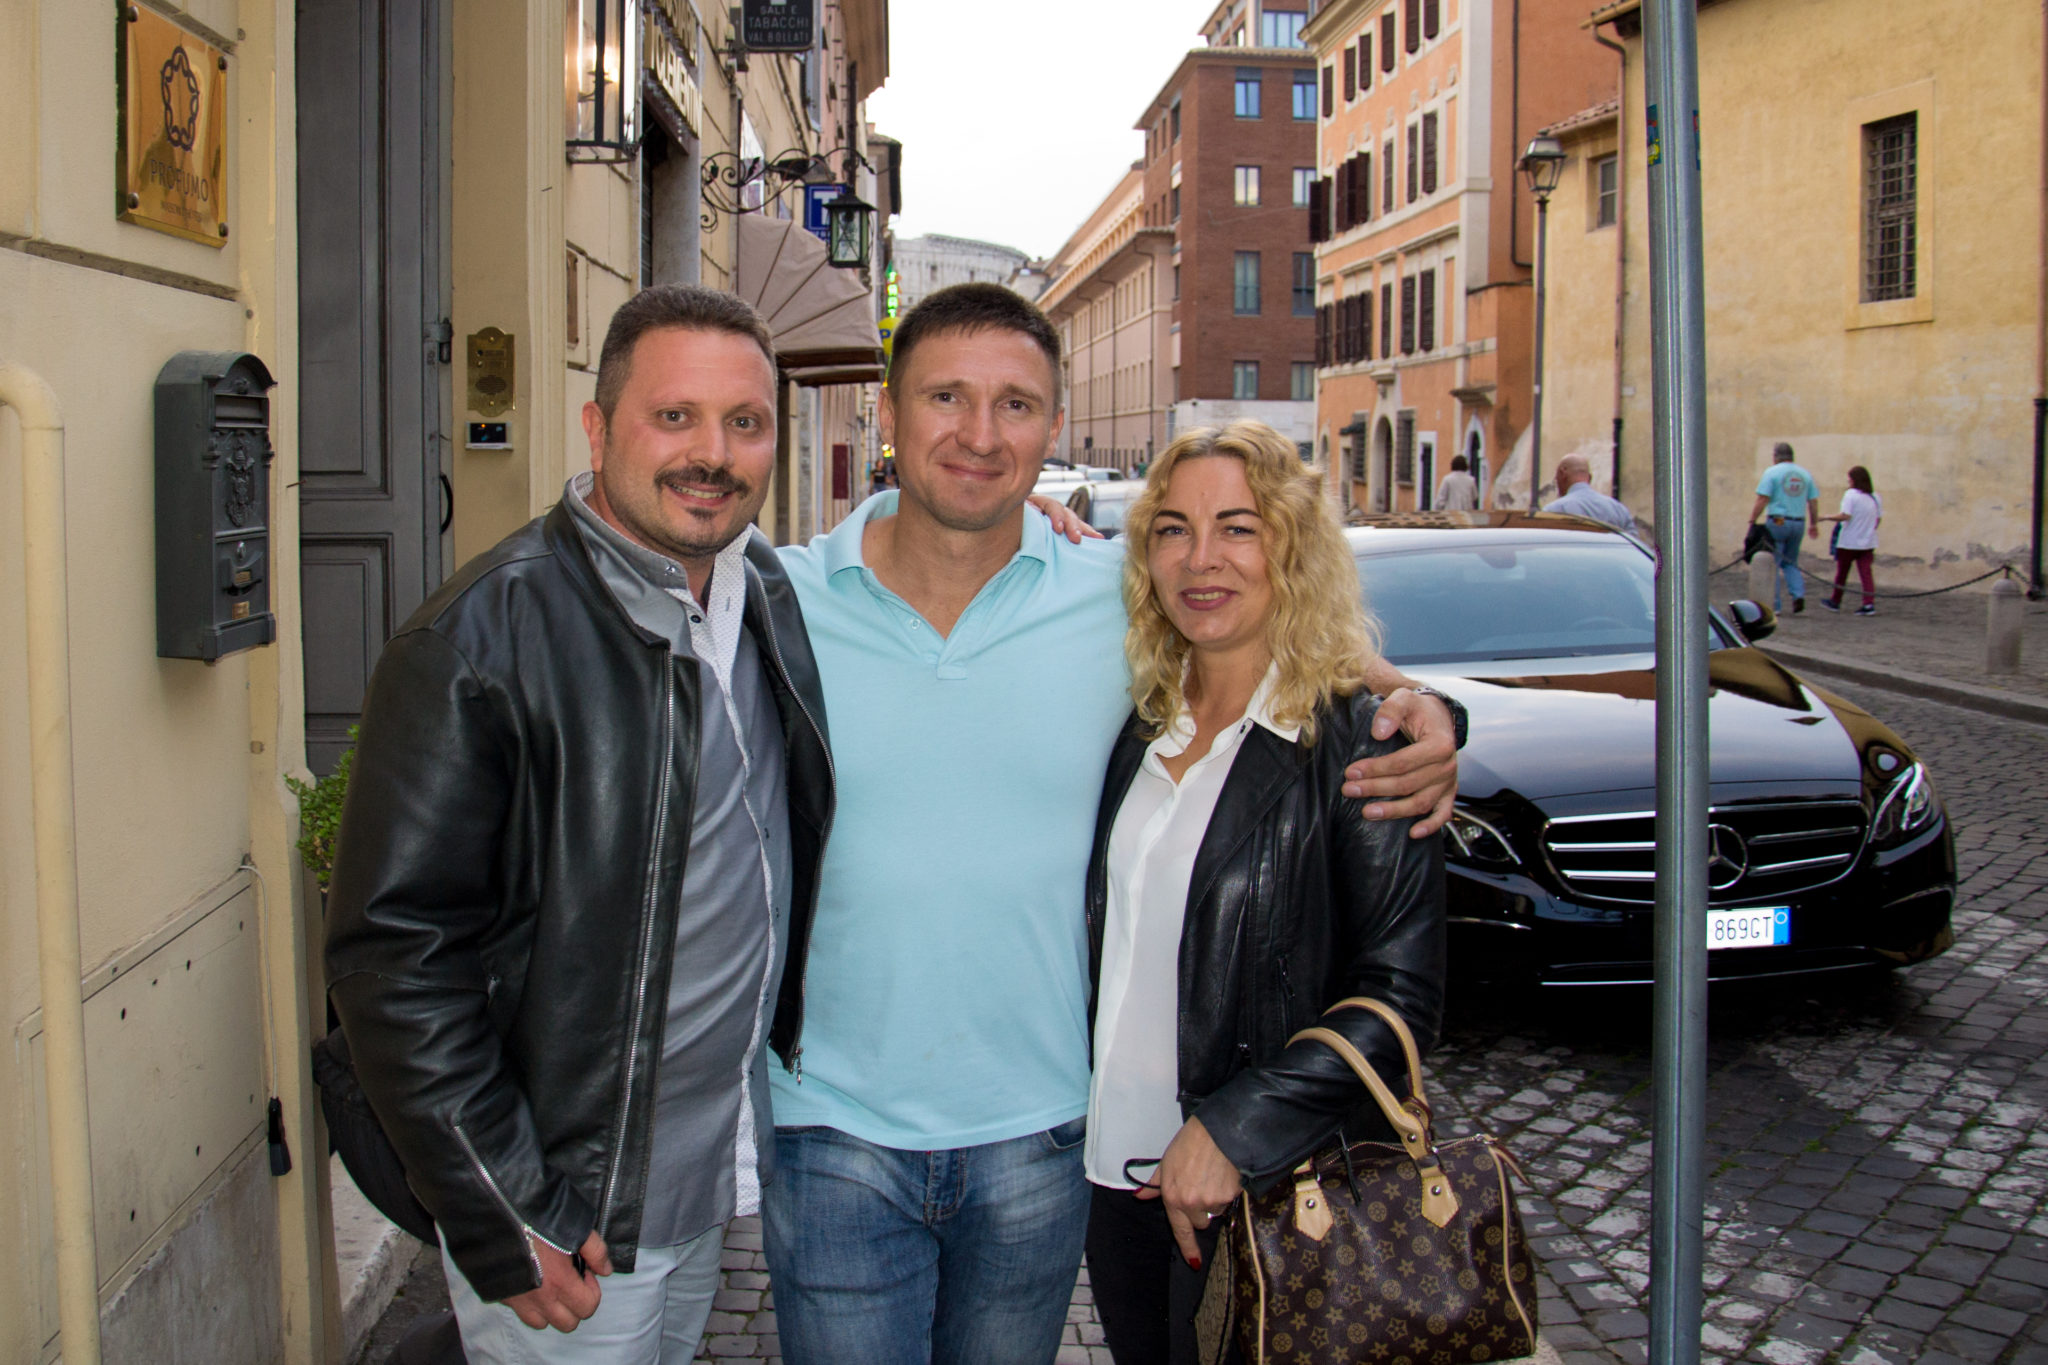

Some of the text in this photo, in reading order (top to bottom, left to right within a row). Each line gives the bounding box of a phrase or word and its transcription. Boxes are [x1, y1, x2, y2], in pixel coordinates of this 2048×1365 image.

[760, 5, 786, 15] SALI
[748, 16, 809, 29] TABACCHI
[151, 159, 209, 202] PROFUMO
[1714, 916, 1772, 941] 869GT
